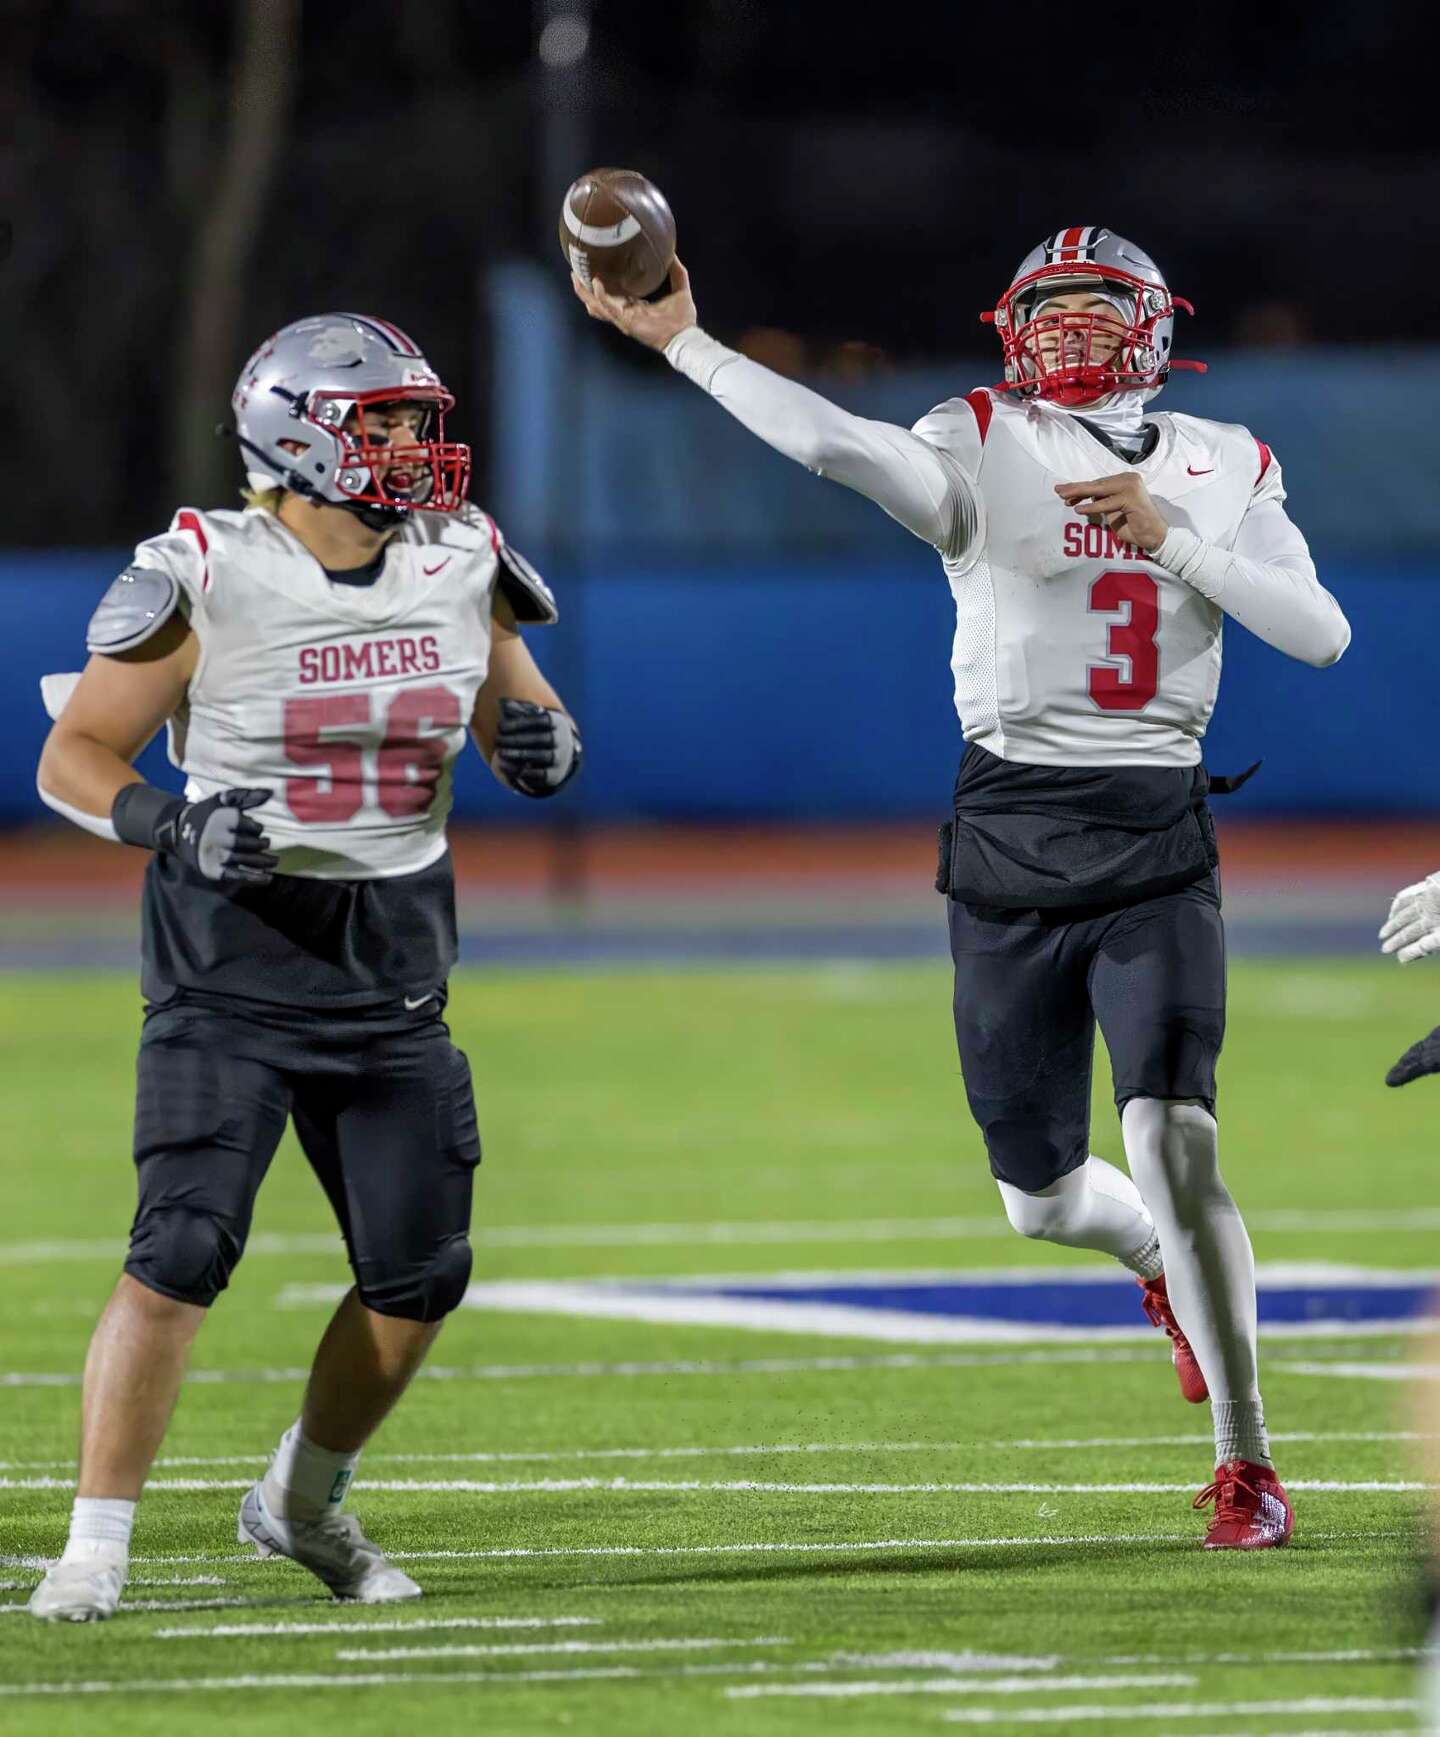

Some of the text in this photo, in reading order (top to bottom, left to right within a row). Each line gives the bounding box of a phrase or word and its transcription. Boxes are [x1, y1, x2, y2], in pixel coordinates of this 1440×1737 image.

[298, 635, 441, 684] SOMERS
[1087, 569, 1161, 713] 3
[283, 683, 462, 824] 56
